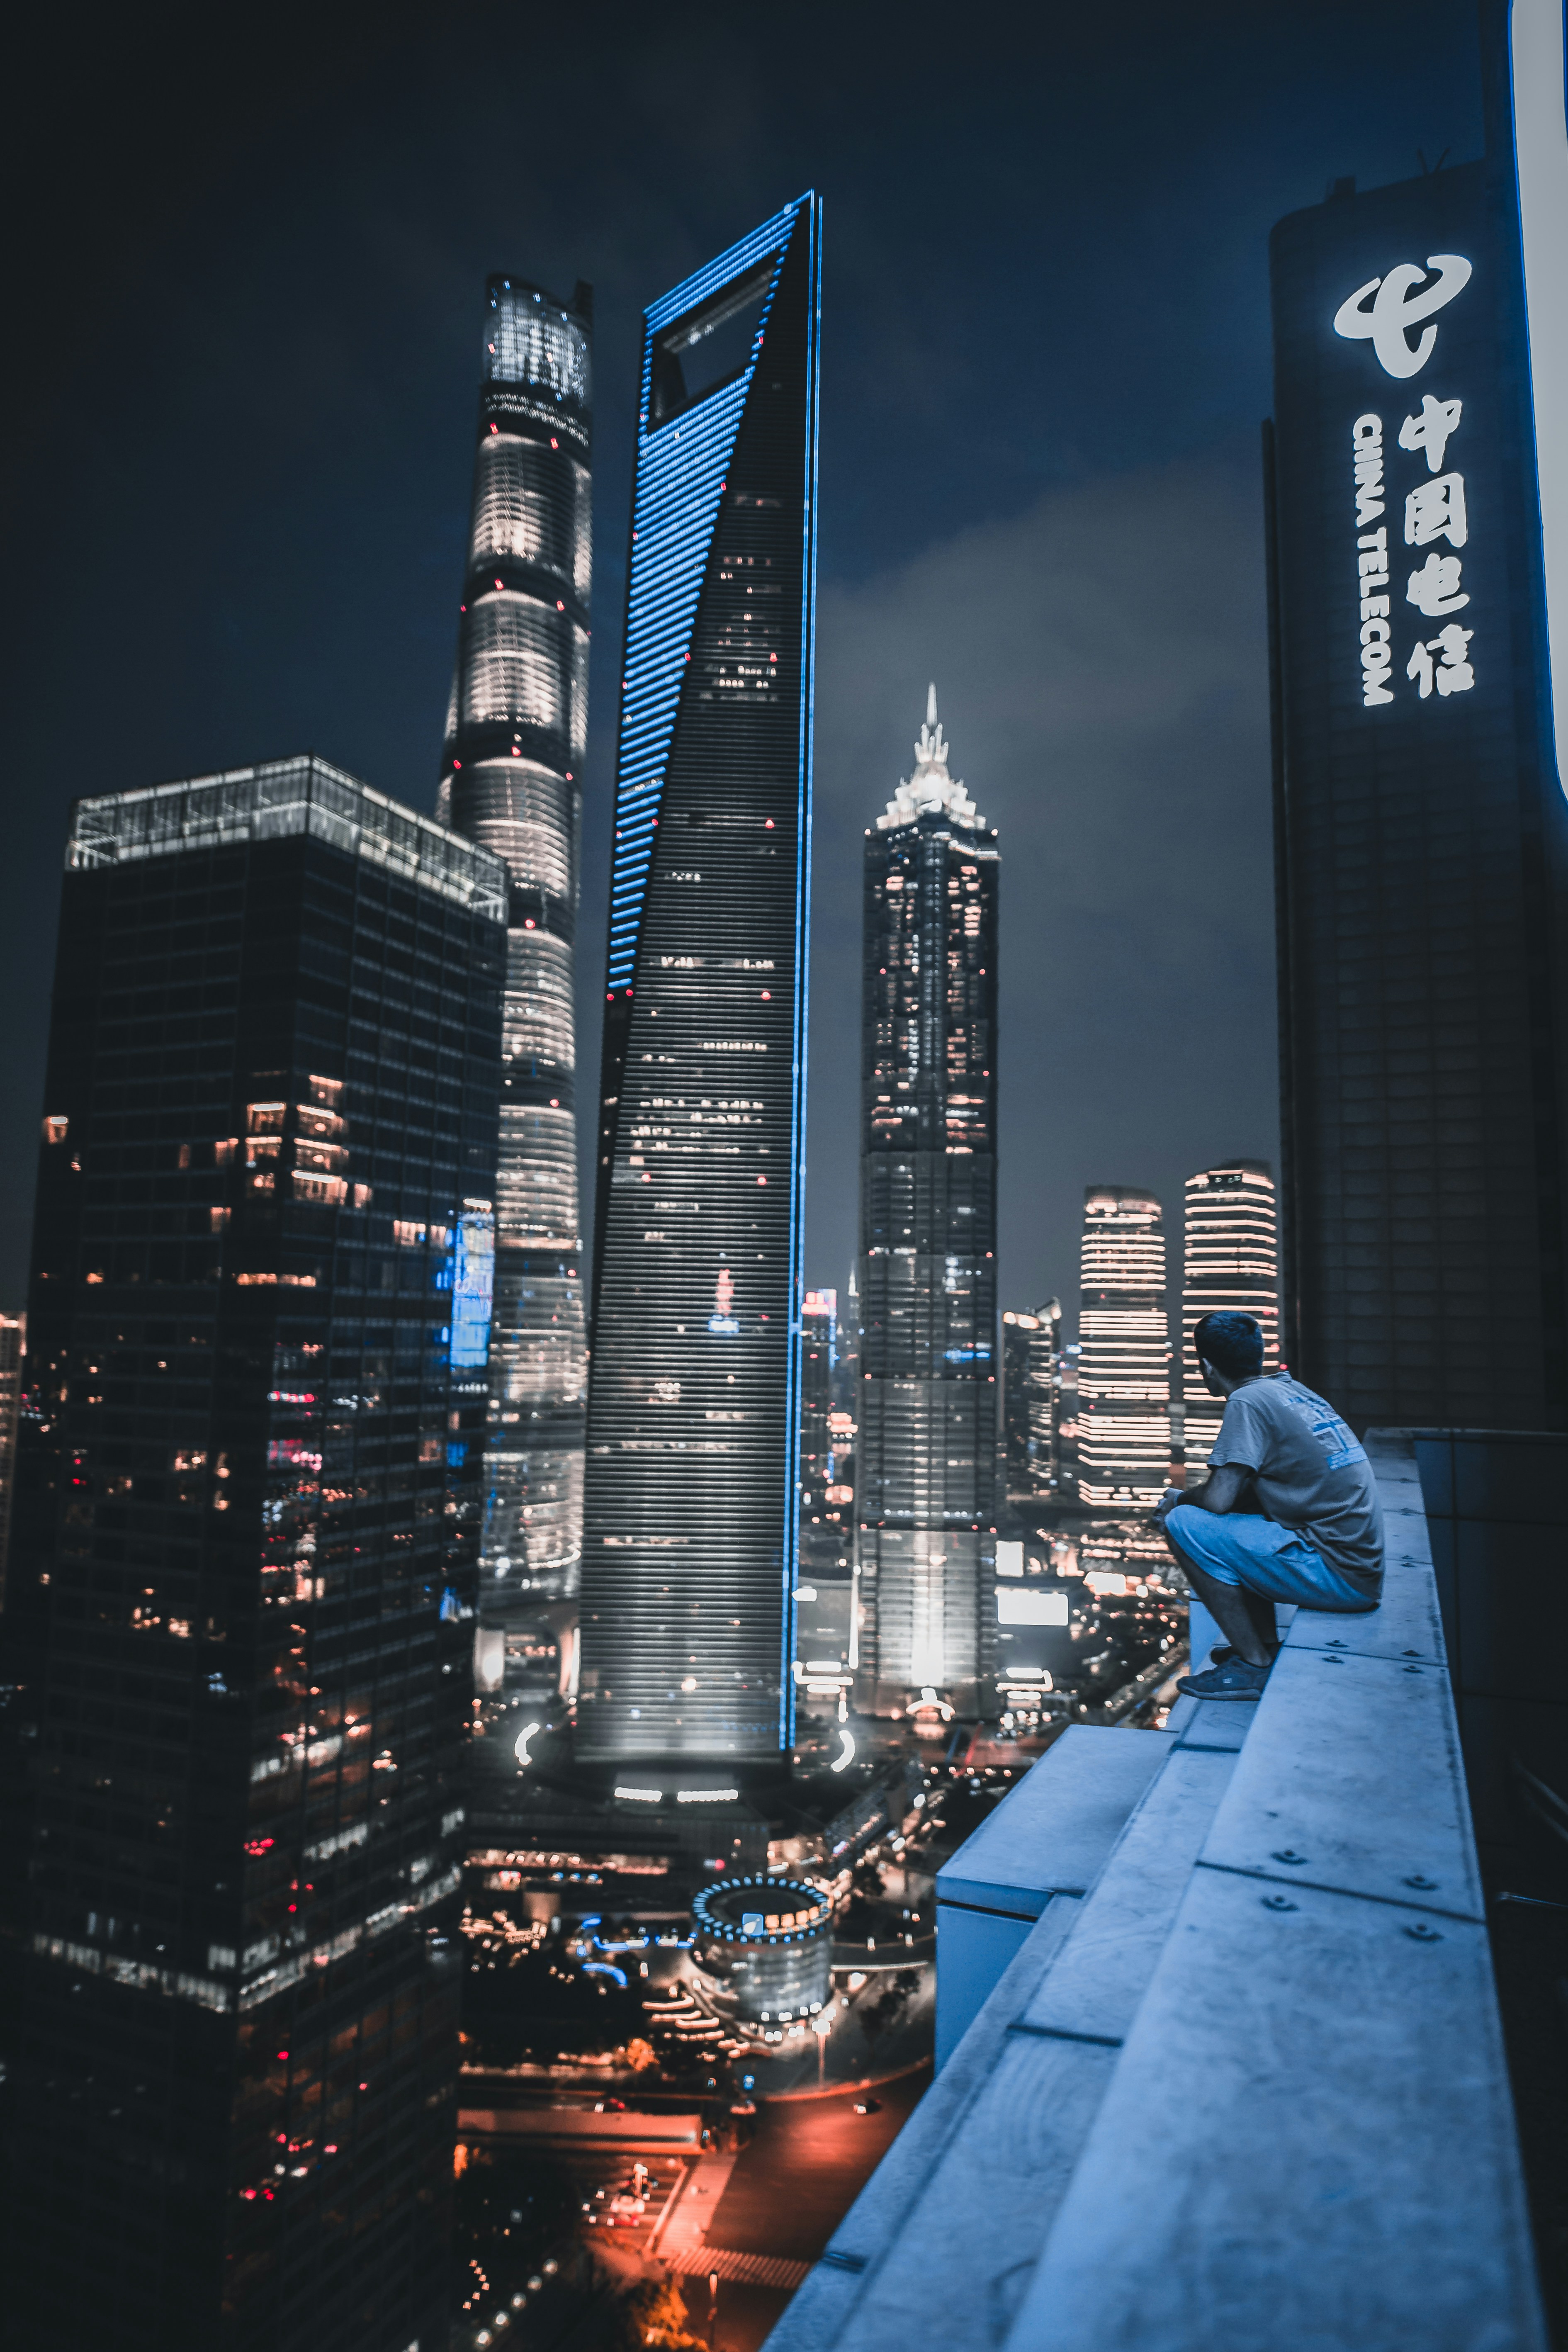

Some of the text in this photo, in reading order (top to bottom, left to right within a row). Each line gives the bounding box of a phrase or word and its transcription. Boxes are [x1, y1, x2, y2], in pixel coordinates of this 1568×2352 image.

[1352, 413, 1394, 707] CHINA TELECOM
[1398, 394, 1475, 699] 中国电信
